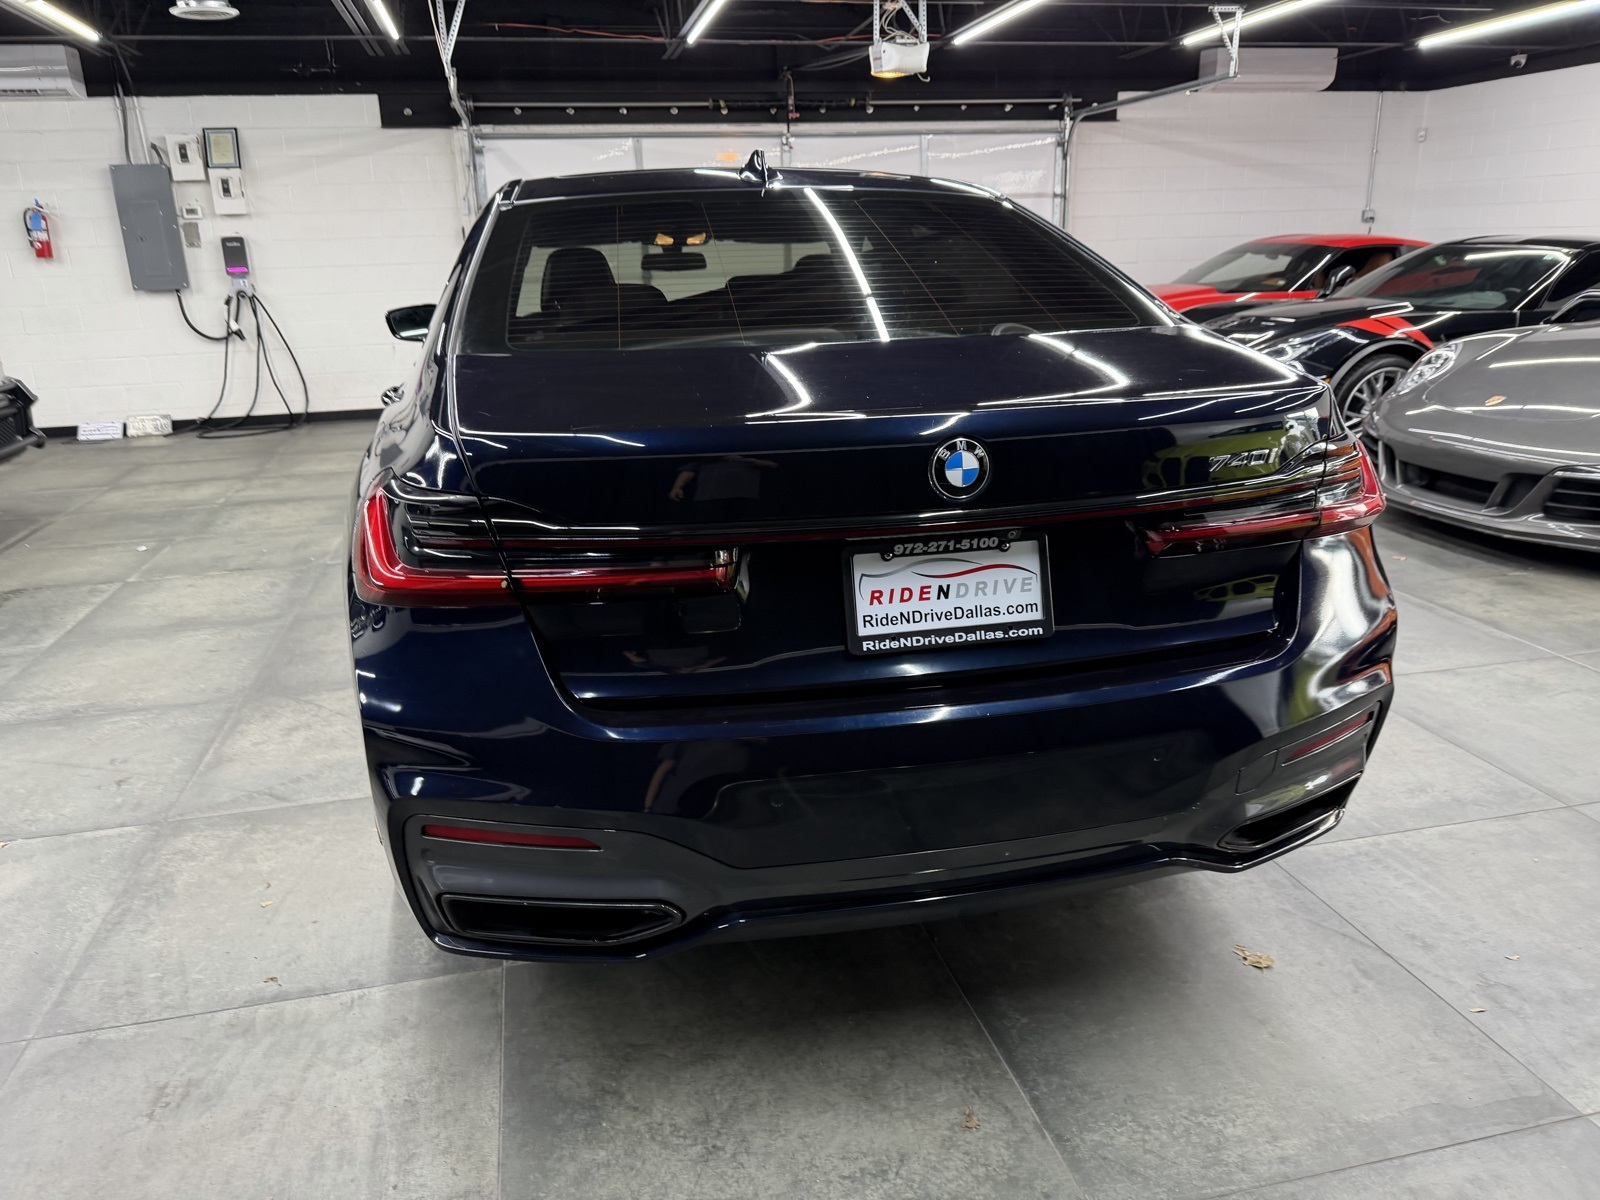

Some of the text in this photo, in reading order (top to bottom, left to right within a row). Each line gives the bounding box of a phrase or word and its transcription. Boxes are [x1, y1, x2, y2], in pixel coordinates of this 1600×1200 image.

[938, 440, 985, 461] BMW
[893, 536, 999, 555] 972-271-5100
[862, 602, 1039, 629] RideNDriveDallas.com
[862, 625, 1044, 652] RideNDriveDallas.com
